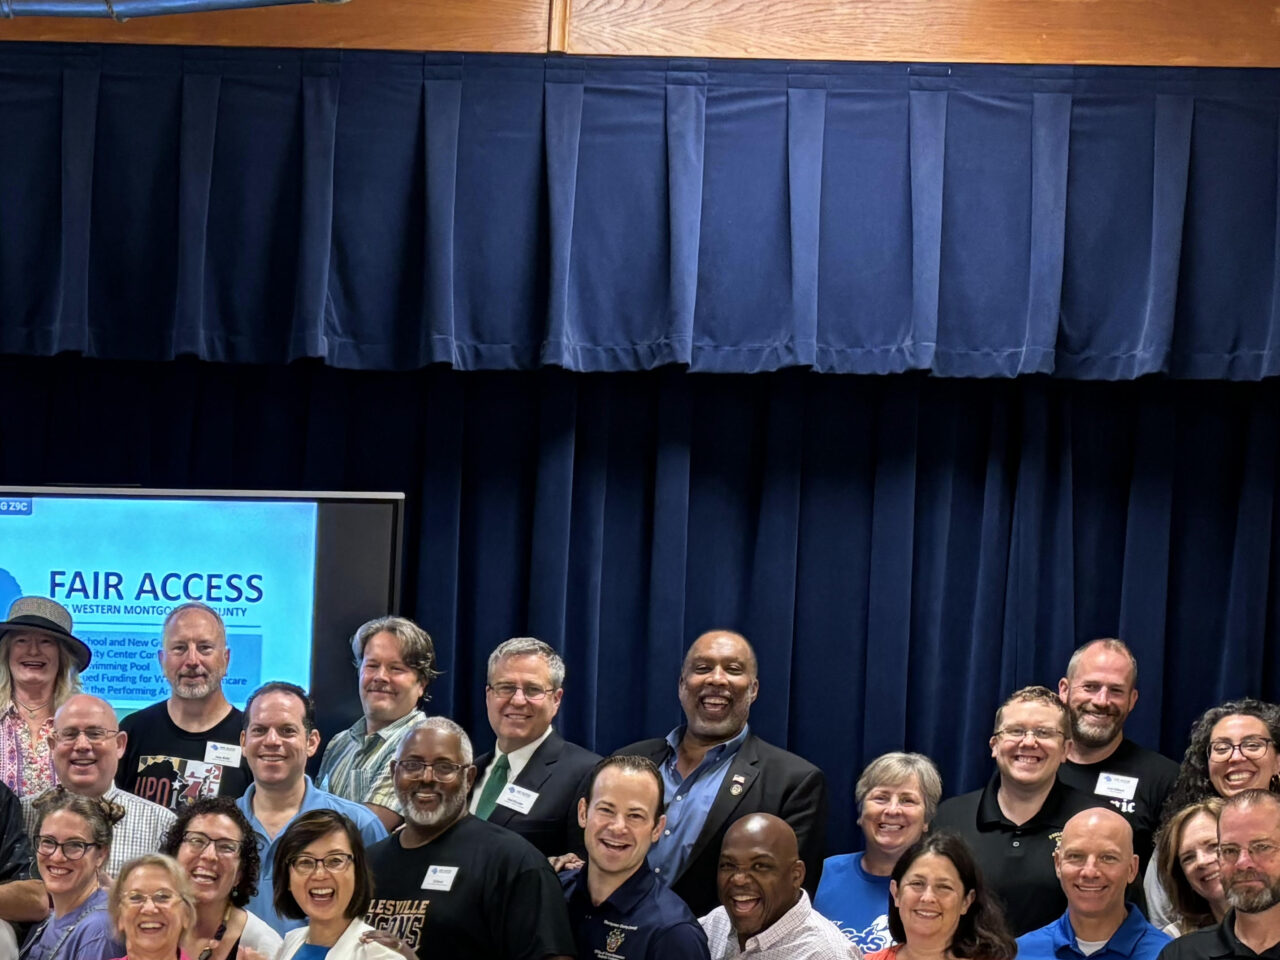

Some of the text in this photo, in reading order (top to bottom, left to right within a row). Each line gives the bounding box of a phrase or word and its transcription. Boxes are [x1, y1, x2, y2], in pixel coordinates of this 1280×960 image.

[9, 502, 28, 511] Z9C
[49, 570, 264, 602] FAIR ACCESS
[72, 604, 122, 615] WESTERN
[214, 607, 247, 617] UNTY
[86, 637, 108, 647] hool
[108, 638, 126, 647] and
[128, 638, 149, 647] New
[106, 649, 137, 659] Center
[130, 662, 150, 671] Pool
[101, 673, 137, 685] Funding
[138, 674, 152, 683] for
[90, 686, 106, 694] the
[107, 686, 157, 698] Performing
